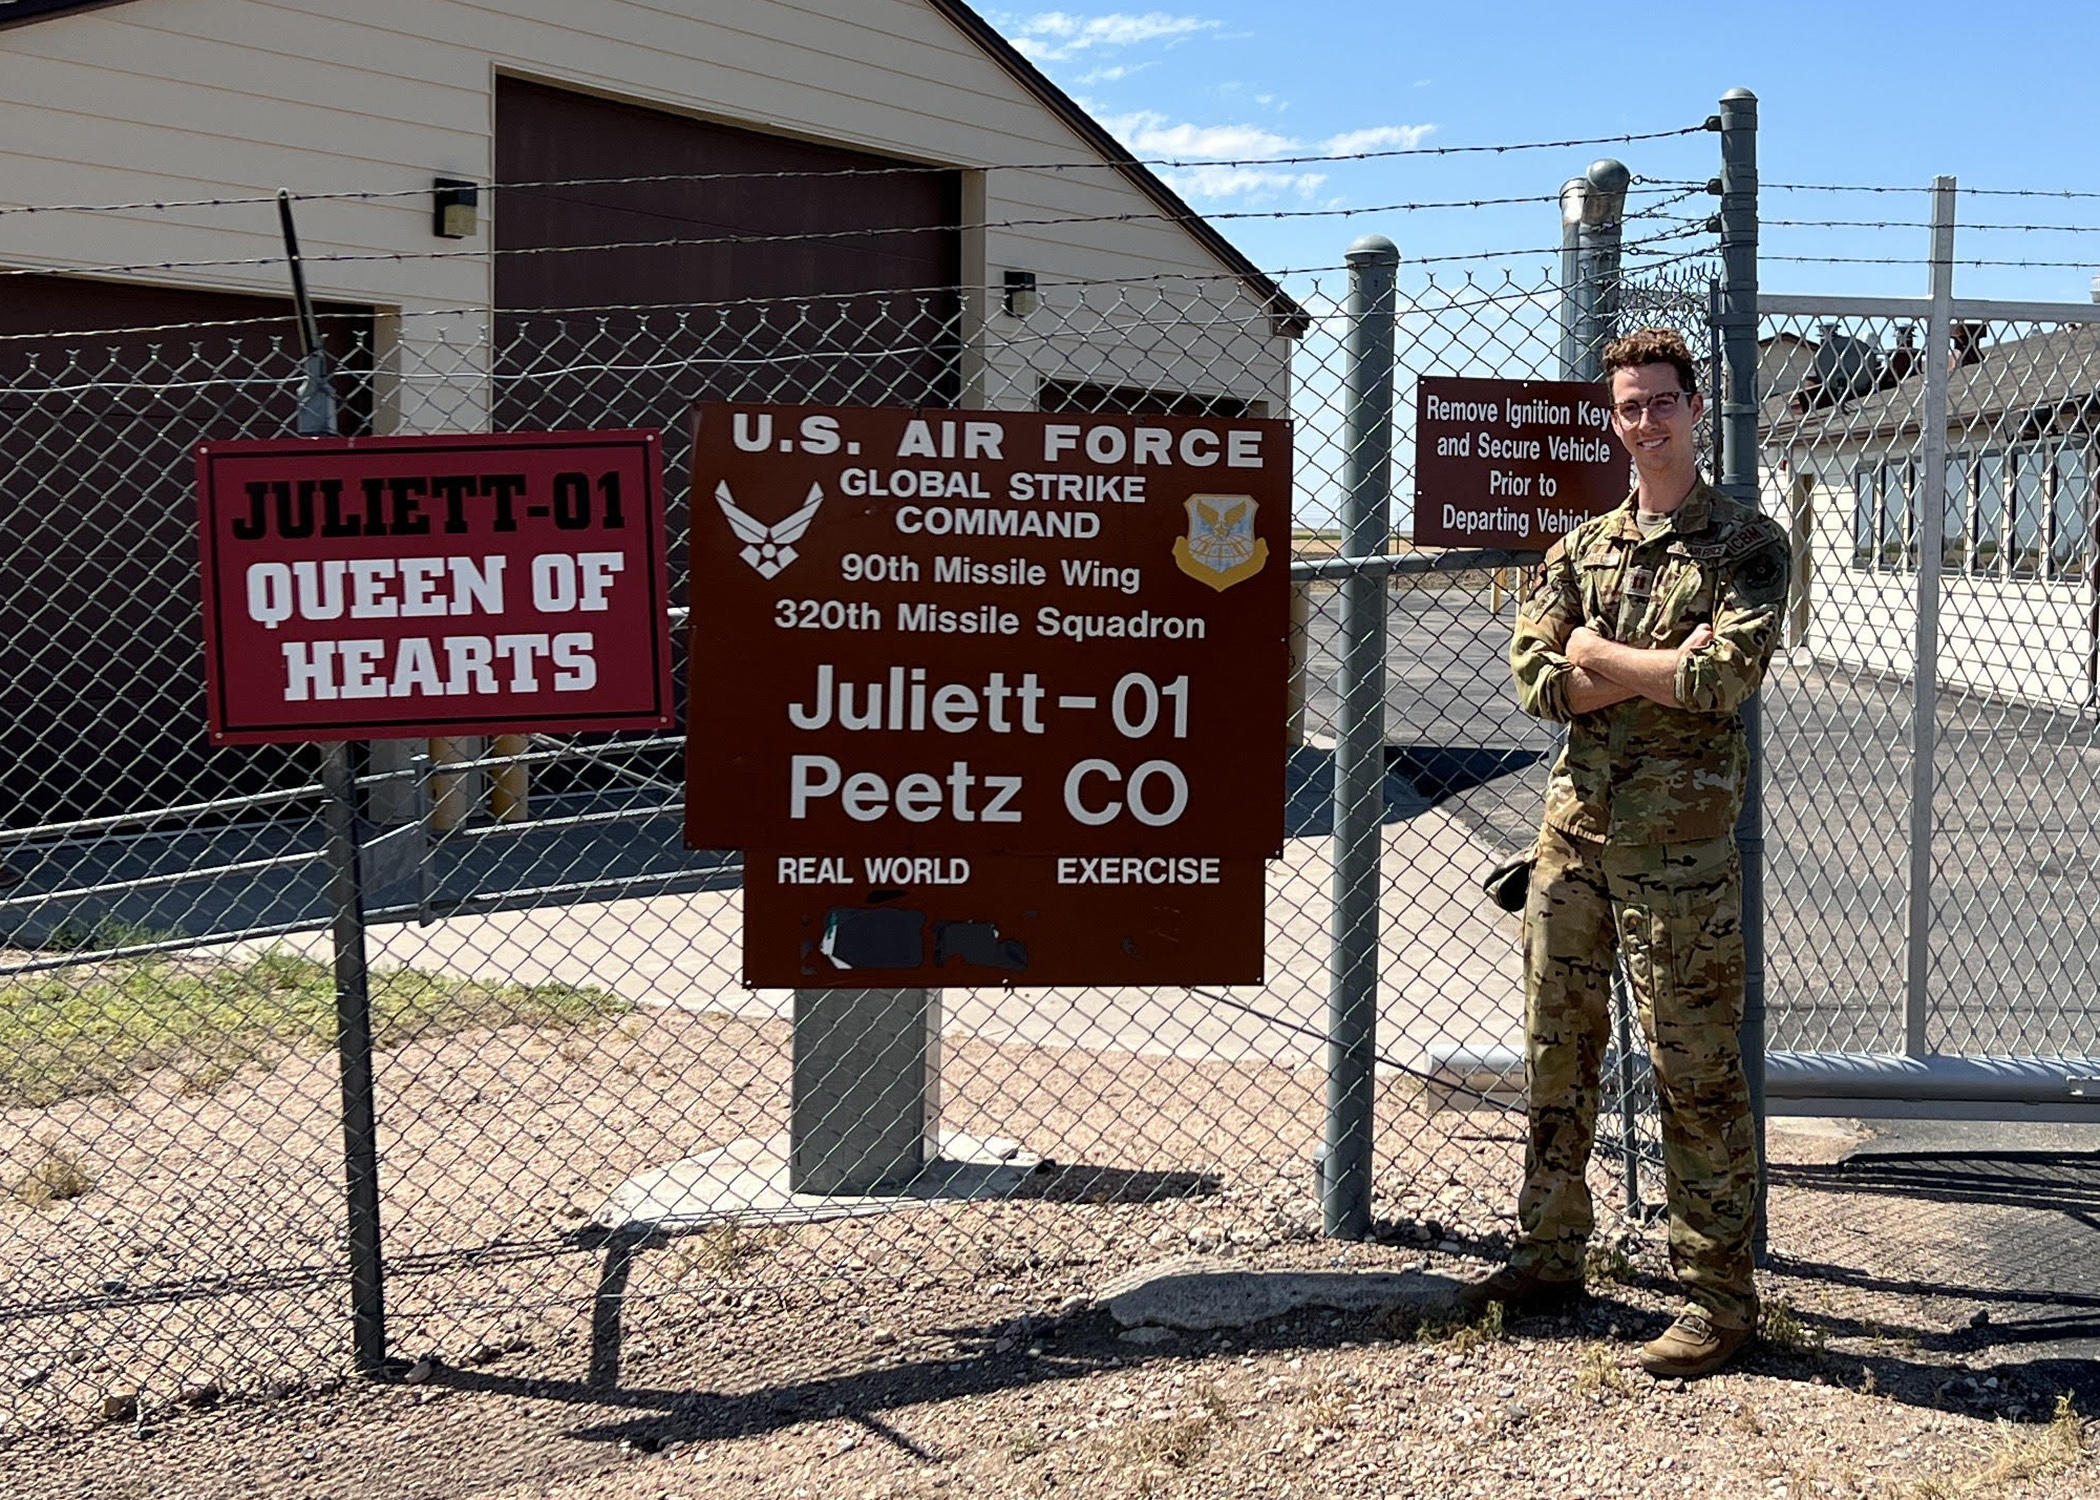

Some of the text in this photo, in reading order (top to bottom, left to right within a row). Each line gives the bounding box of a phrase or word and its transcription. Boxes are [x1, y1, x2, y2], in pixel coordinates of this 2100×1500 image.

[1426, 394, 1612, 432] Remove Ignition Key
[733, 413, 1264, 468] U.S. AIR FORCE
[1436, 431, 1611, 463] and Secure Vehicle
[839, 467, 1146, 503] GLOBAL STRIKE
[1489, 469, 1557, 497] Prior to
[231, 470, 626, 541] JULIETT-01
[895, 505, 1101, 539] COMMAND
[1442, 503, 1530, 538] Departing
[1726, 525, 1764, 553] ICBM
[246, 551, 625, 630] QUEEN OF
[841, 553, 1140, 595] 90th Missile Wing
[774, 598, 1206, 643] 320th Missile Squadron
[281, 632, 597, 702] HEARTS
[790, 754, 1189, 827] Peetz CO
[777, 856, 970, 885] REAL WORLD
[1057, 857, 1220, 885] EXERCISE
